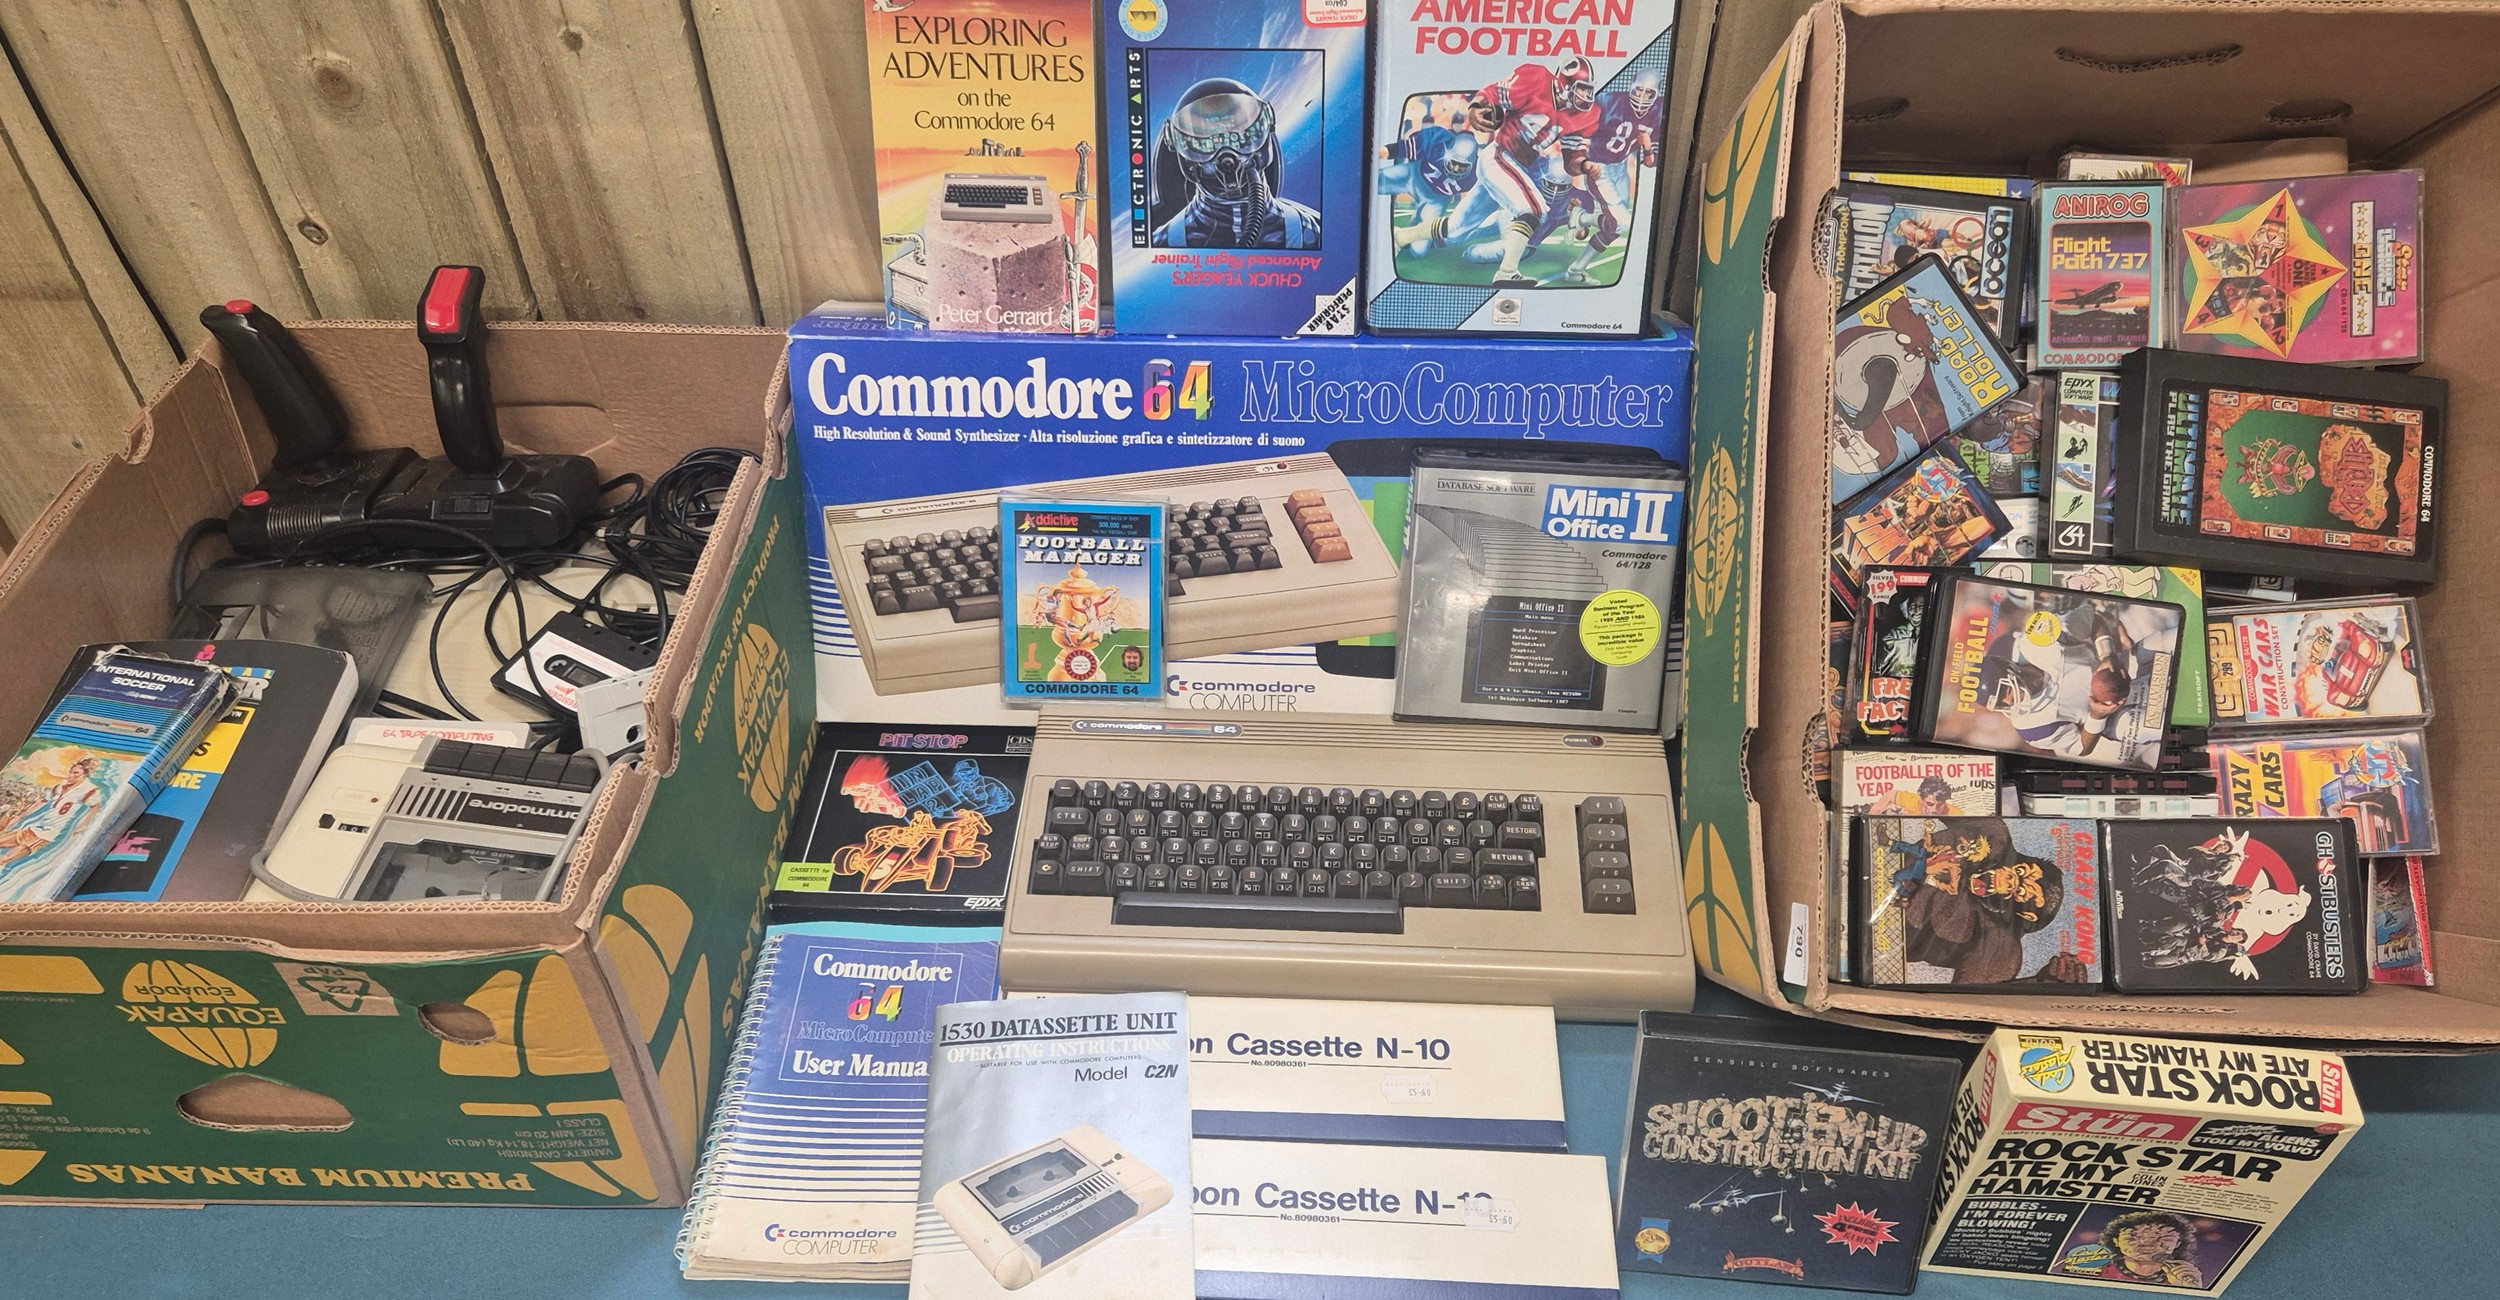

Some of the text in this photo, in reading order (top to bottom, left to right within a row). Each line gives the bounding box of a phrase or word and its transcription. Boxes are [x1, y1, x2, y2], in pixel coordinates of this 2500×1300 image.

[1410, 0, 1635, 25] AMERICAN
[894, 16, 1067, 48] EXPLORING
[1415, 26, 1629, 58] FOOTBALL
[883, 52, 1085, 83] ADVENTURES
[957, 88, 1011, 107] on the
[914, 110, 1056, 132] Commodore 64
[2053, 192, 2150, 219] ANIROG
[2052, 237, 2111, 256] Flight
[1151, 252, 1322, 272] Advanced Flight Trainer
[2052, 251, 2150, 270] Path 737
[939, 302, 1054, 327] Peter Gerrard
[1560, 321, 1623, 331] Commodore 64
[2052, 334, 2148, 343] ADVANCED PILOT TRAINER
[808, 352, 1673, 429] Commodore 64 MicroComputer
[813, 425, 1305, 447] High Resolution & Sound Synthesizer Alta risoluzione grafica e sintetizzatore di suono
[2160, 391, 2179, 523] PLAY THE GAME
[1437, 481, 1484, 491] DATABASE
[2420, 445, 2435, 523] COMMODORE 64
[1549, 488, 1673, 541] Mini II
[1547, 516, 1625, 540] Office
[1018, 536, 1146, 551] FOOTBALL
[1024, 551, 1143, 566] MANAGER
[1602, 550, 1668, 561] Commodore
[1616, 560, 1651, 570] 64/128
[96, 664, 195, 687] INTERNATIONAL
[1957, 617, 1990, 715] FOOTBALL
[2222, 661, 2234, 676] 299
[2253, 617, 2281, 719] WAR CARS
[2271, 624, 2289, 711] CONSTRUCTION SET
[111, 676, 165, 692] SOCCER
[1025, 683, 1140, 696] COMMODORE 64
[1192, 681, 1316, 693] commodore
[2194, 669, 2203, 715] PEAKSOFT
[1189, 692, 1298, 712] COMPUTER
[68, 717, 149, 735] commodore 64
[382, 729, 399, 738] 64
[400, 729, 430, 740] TAPE
[1090, 721, 1238, 734] commodore 64
[879, 733, 969, 749] PIT STOP
[1855, 762, 1995, 781] FOOTBALLER OF THE
[2263, 750, 2285, 809] CARS
[1056, 811, 1084, 820] CTRL
[1506, 826, 1537, 835] RESTORE
[1491, 853, 1524, 862] RETURN
[1070, 865, 1101, 873] SHIFT
[2073, 831, 2097, 966] CRAZY KONG
[1794, 924, 1805, 960] 790
[303, 966, 345, 976] PAP
[813, 953, 953, 981] Commodore
[134, 985, 236, 997] ECUADOR
[336, 984, 350, 994] 22
[847, 983, 905, 1022] 64
[116, 1004, 287, 1025] EQUAPAK
[940, 1011, 1178, 1042] 1530 DATASSETTE UNIT
[947, 1042, 1044, 1064] OPERATING
[1050, 1036, 1171, 1058] INSTRUCTIONS
[1226, 1032, 1363, 1059] Cassette
[1376, 1037, 1451, 1061] N-10
[1104, 1054, 1142, 1062] COMPUTERS
[1250, 1059, 1307, 1068] No.80980361
[1693, 1056, 1779, 1069] SENSIBLE
[2081, 1039, 2309, 1077] ATE MY HAMSTER
[1074, 1064, 1178, 1082] Model C2N
[2086, 1061, 2325, 1113] ROCK STAR
[2110, 1111, 2143, 1121] THE
[532, 1128, 548, 1138] 20
[550, 1128, 573, 1137] MIN
[576, 1128, 604, 1137] SIZE:
[2258, 1133, 2321, 1148] ALIENS
[498, 1148, 613, 1158] VARIETY: CAVENDISH
[2191, 1136, 2321, 1157] STOLE MY VOLVO!
[1643, 1133, 1922, 1181] CONSTRUCTION KIT
[1987, 1138, 2283, 1182] ROCK STAR
[66, 1162, 536, 1192] PREMIUM BANANAS
[1978, 1160, 2130, 1182] ATE MY
[2132, 1173, 2168, 1183] COLIN
[1966, 1178, 2161, 1205] HAMSTER
[2127, 1180, 2166, 1188] JONES
[1280, 1213, 1341, 1223] No.80980361
[1957, 1219, 2036, 1230] BLOWING!
[1962, 1210, 2068, 1222] I'M FOREVER
[788, 1228, 897, 1239] commodore
[783, 1239, 879, 1256] COMPUTER
